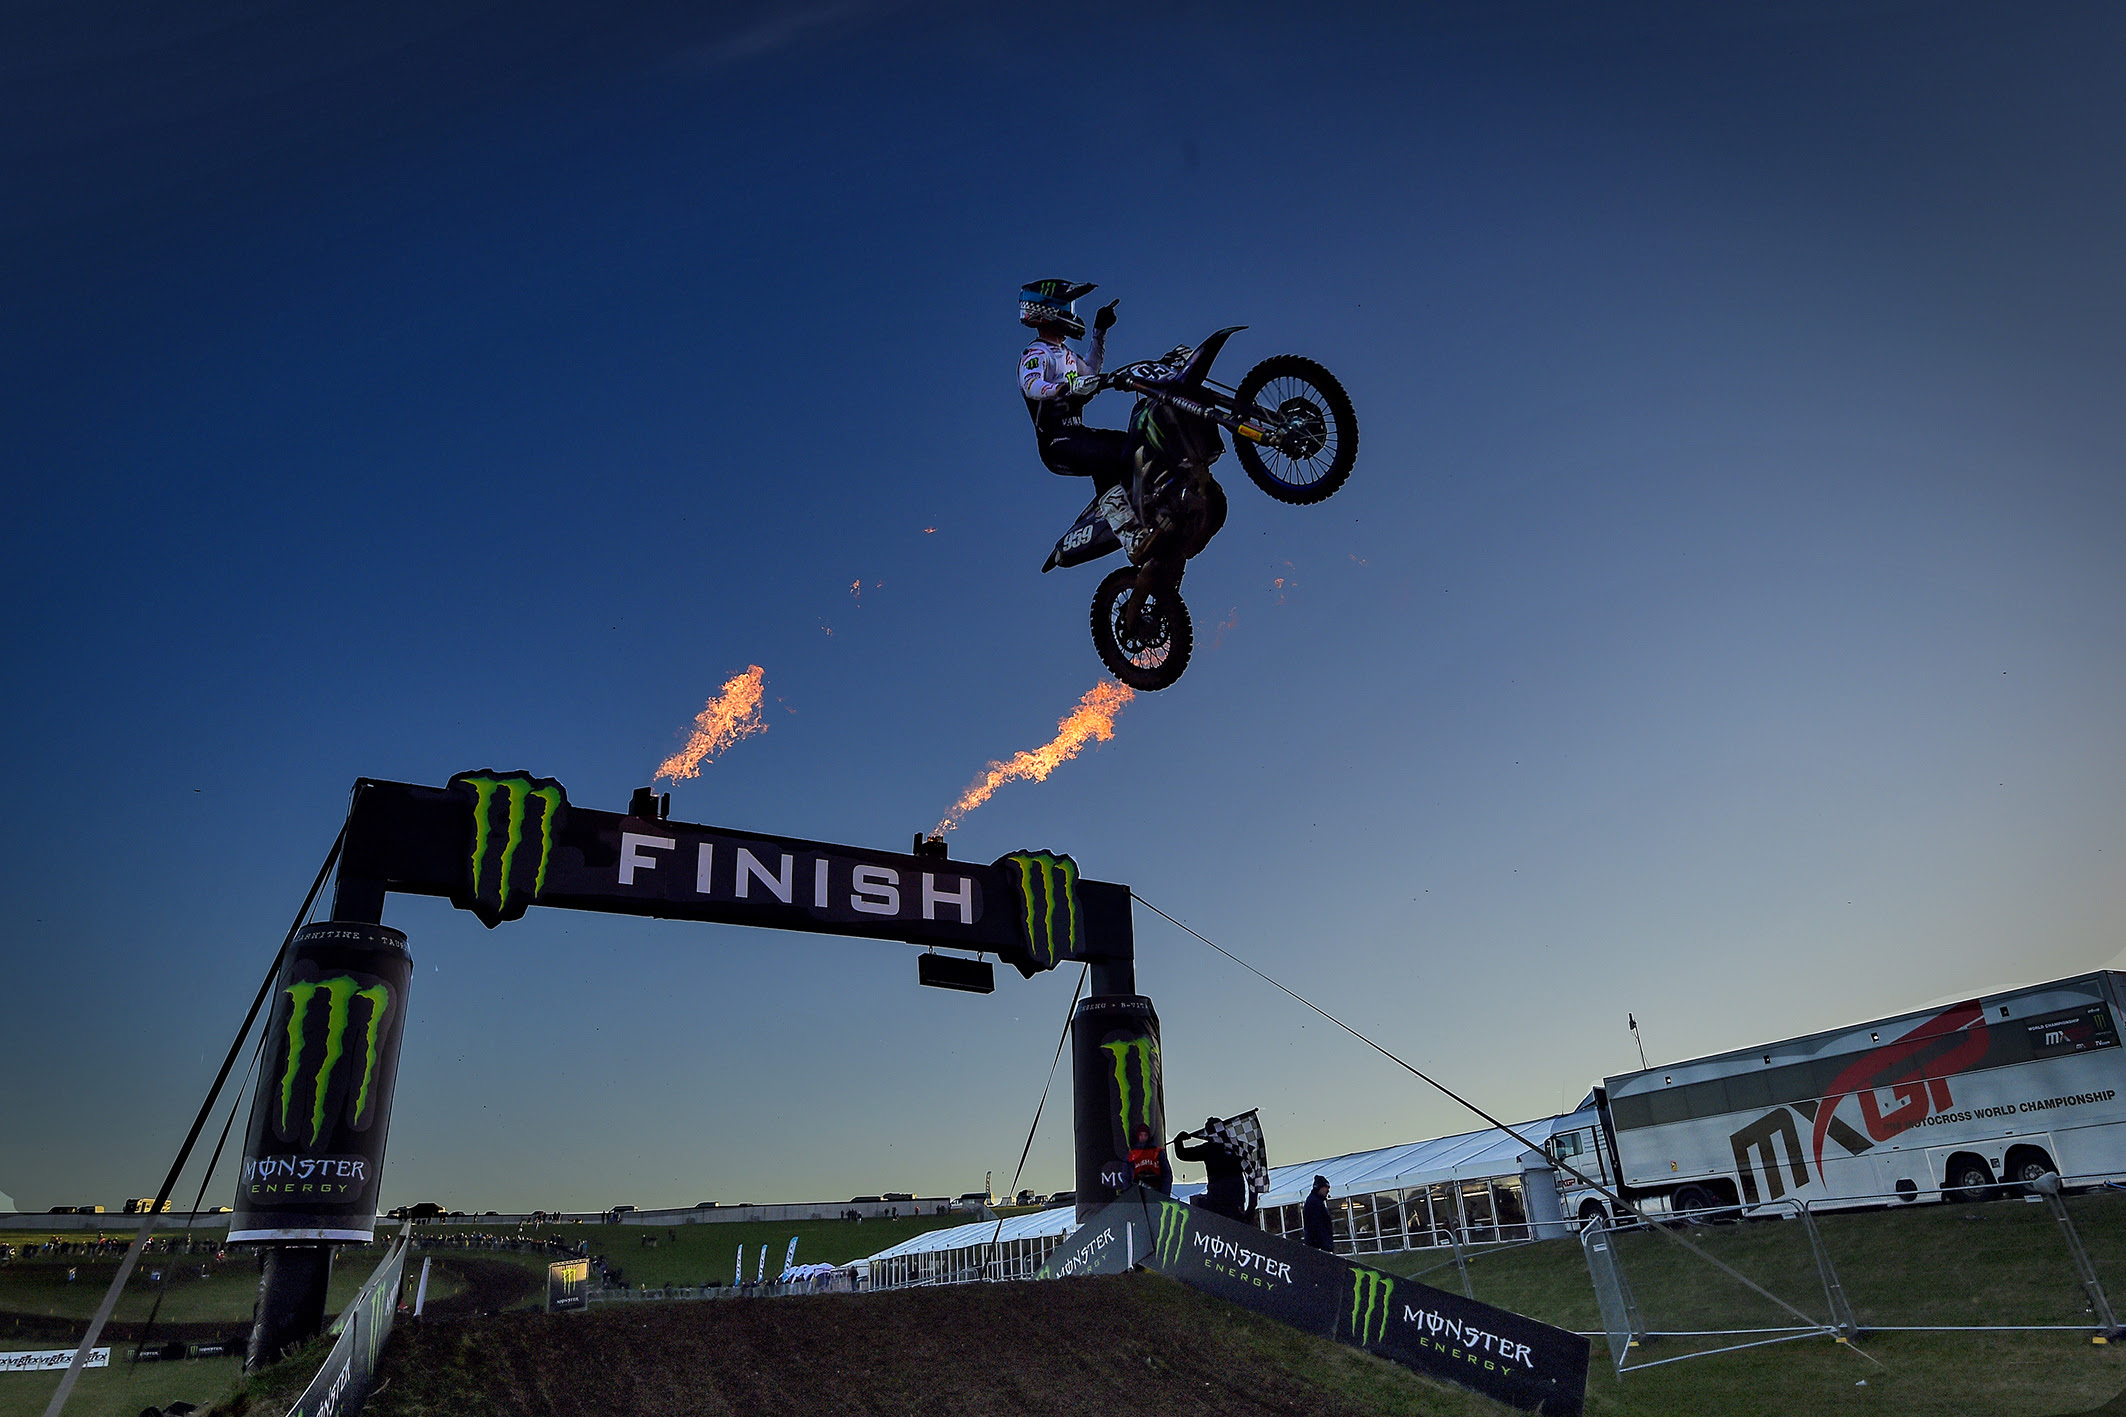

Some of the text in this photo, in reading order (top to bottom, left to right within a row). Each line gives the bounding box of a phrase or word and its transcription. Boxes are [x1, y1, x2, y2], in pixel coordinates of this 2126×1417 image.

[1062, 525, 1094, 551] 959
[618, 832, 972, 924] FINISH
[1905, 1111, 1972, 1129] MOTOCROSS
[1974, 1105, 2016, 1119] WORLD
[2019, 1090, 2116, 1113] CHAMPIONSHIP
[251, 1184, 348, 1193] ENERGY
[1204, 1259, 1274, 1291] ENERGY
[1420, 1336, 1511, 1376] ENERGY
